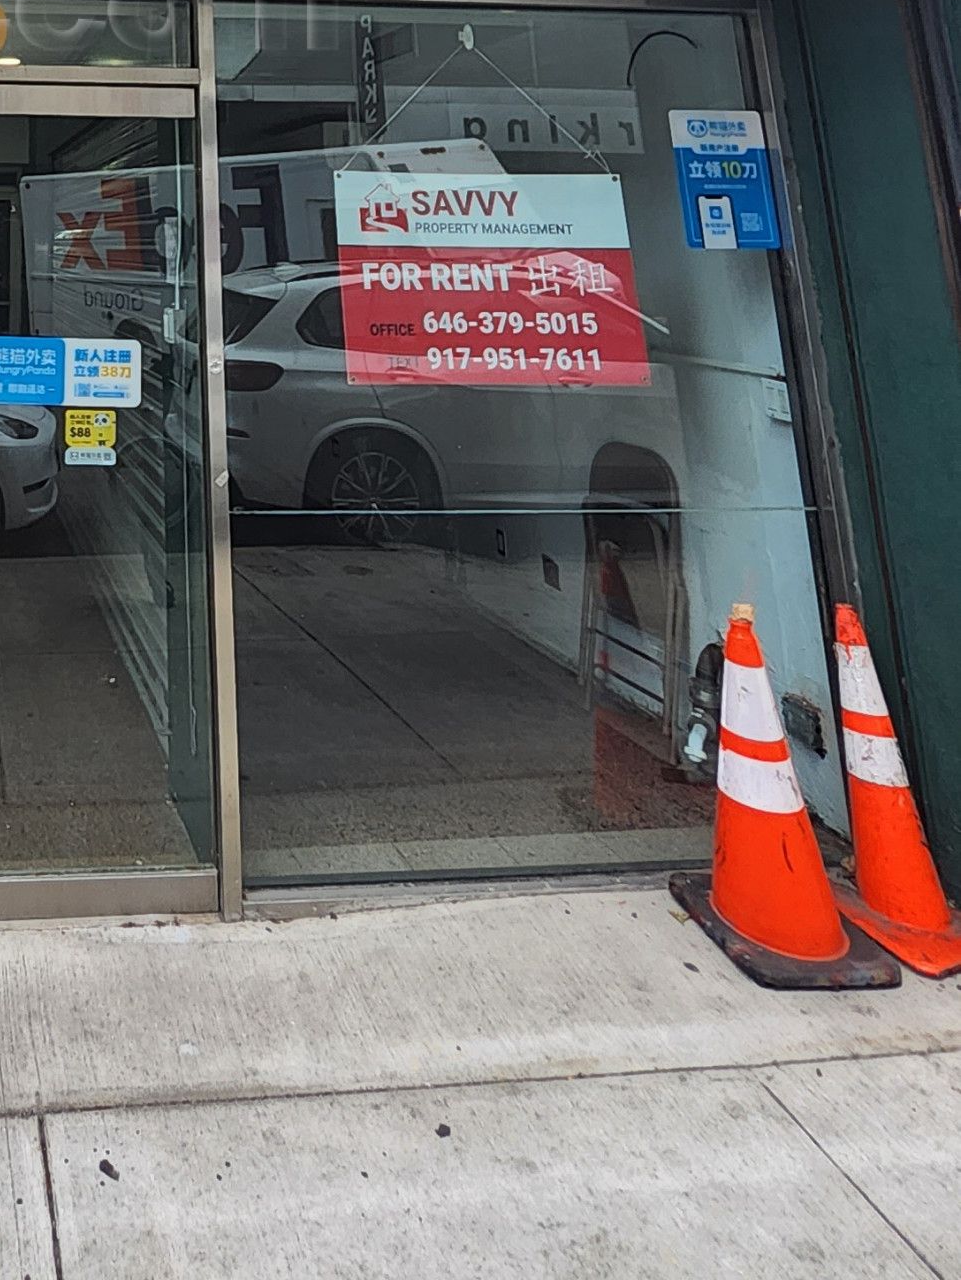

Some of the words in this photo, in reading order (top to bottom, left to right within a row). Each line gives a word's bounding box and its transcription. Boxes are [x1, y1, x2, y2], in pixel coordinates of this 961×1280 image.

[411, 190, 519, 217] SAVVY
[414, 222, 478, 235] PROPERTY
[481, 223, 574, 236] MANAGEMENT
[362, 263, 423, 291] FOR
[431, 264, 513, 292] RENT
[527, 256, 615, 297] 出租
[369, 322, 416, 337] OFFICE
[423, 311, 599, 336] 646-379-5015
[426, 347, 601, 372] 917-951-7611
[69, 426, 92, 438] $88
